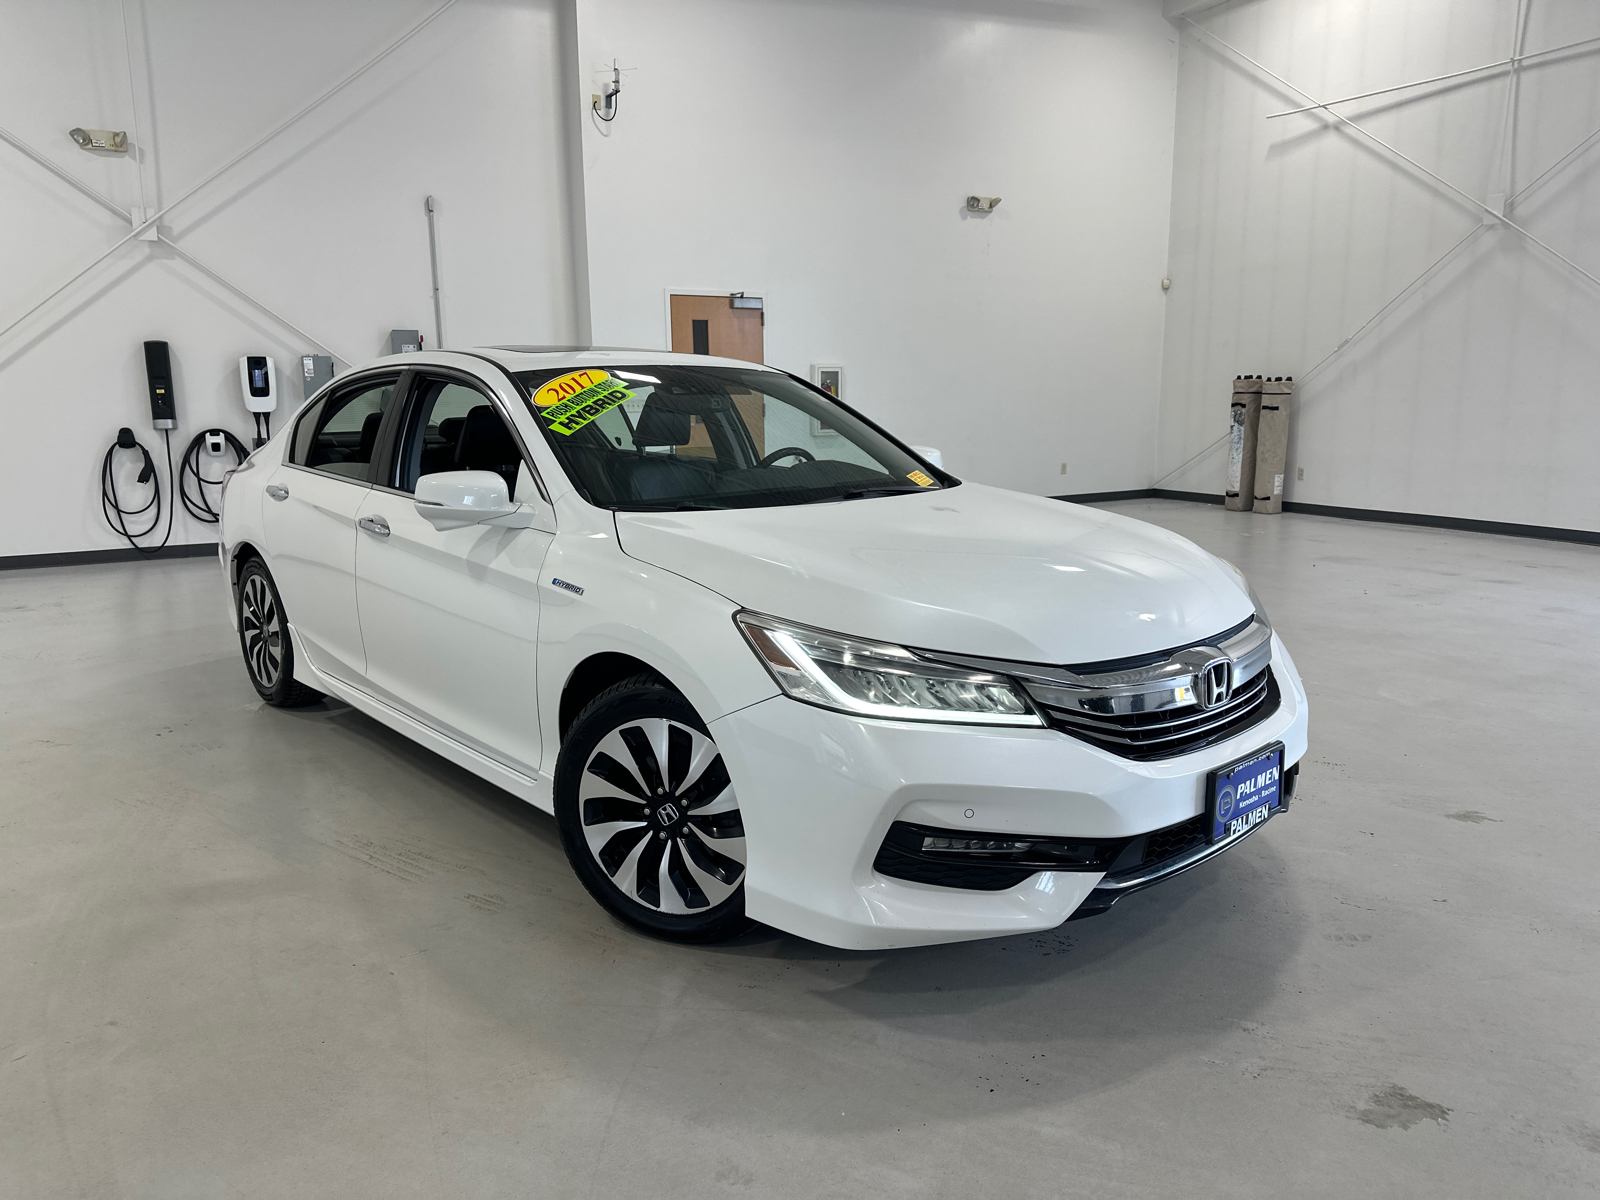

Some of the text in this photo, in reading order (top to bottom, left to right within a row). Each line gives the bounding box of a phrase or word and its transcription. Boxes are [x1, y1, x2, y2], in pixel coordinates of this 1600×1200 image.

[546, 402, 573, 419] PUSH
[566, 387, 602, 409] BUTTON
[547, 372, 594, 402] 2017
[558, 389, 629, 431] HYBRID
[1237, 765, 1280, 799] PALMEN
[1239, 795, 1259, 809] Kenosha
[1261, 785, 1277, 798] Racine
[1230, 804, 1269, 836] PALMEN
